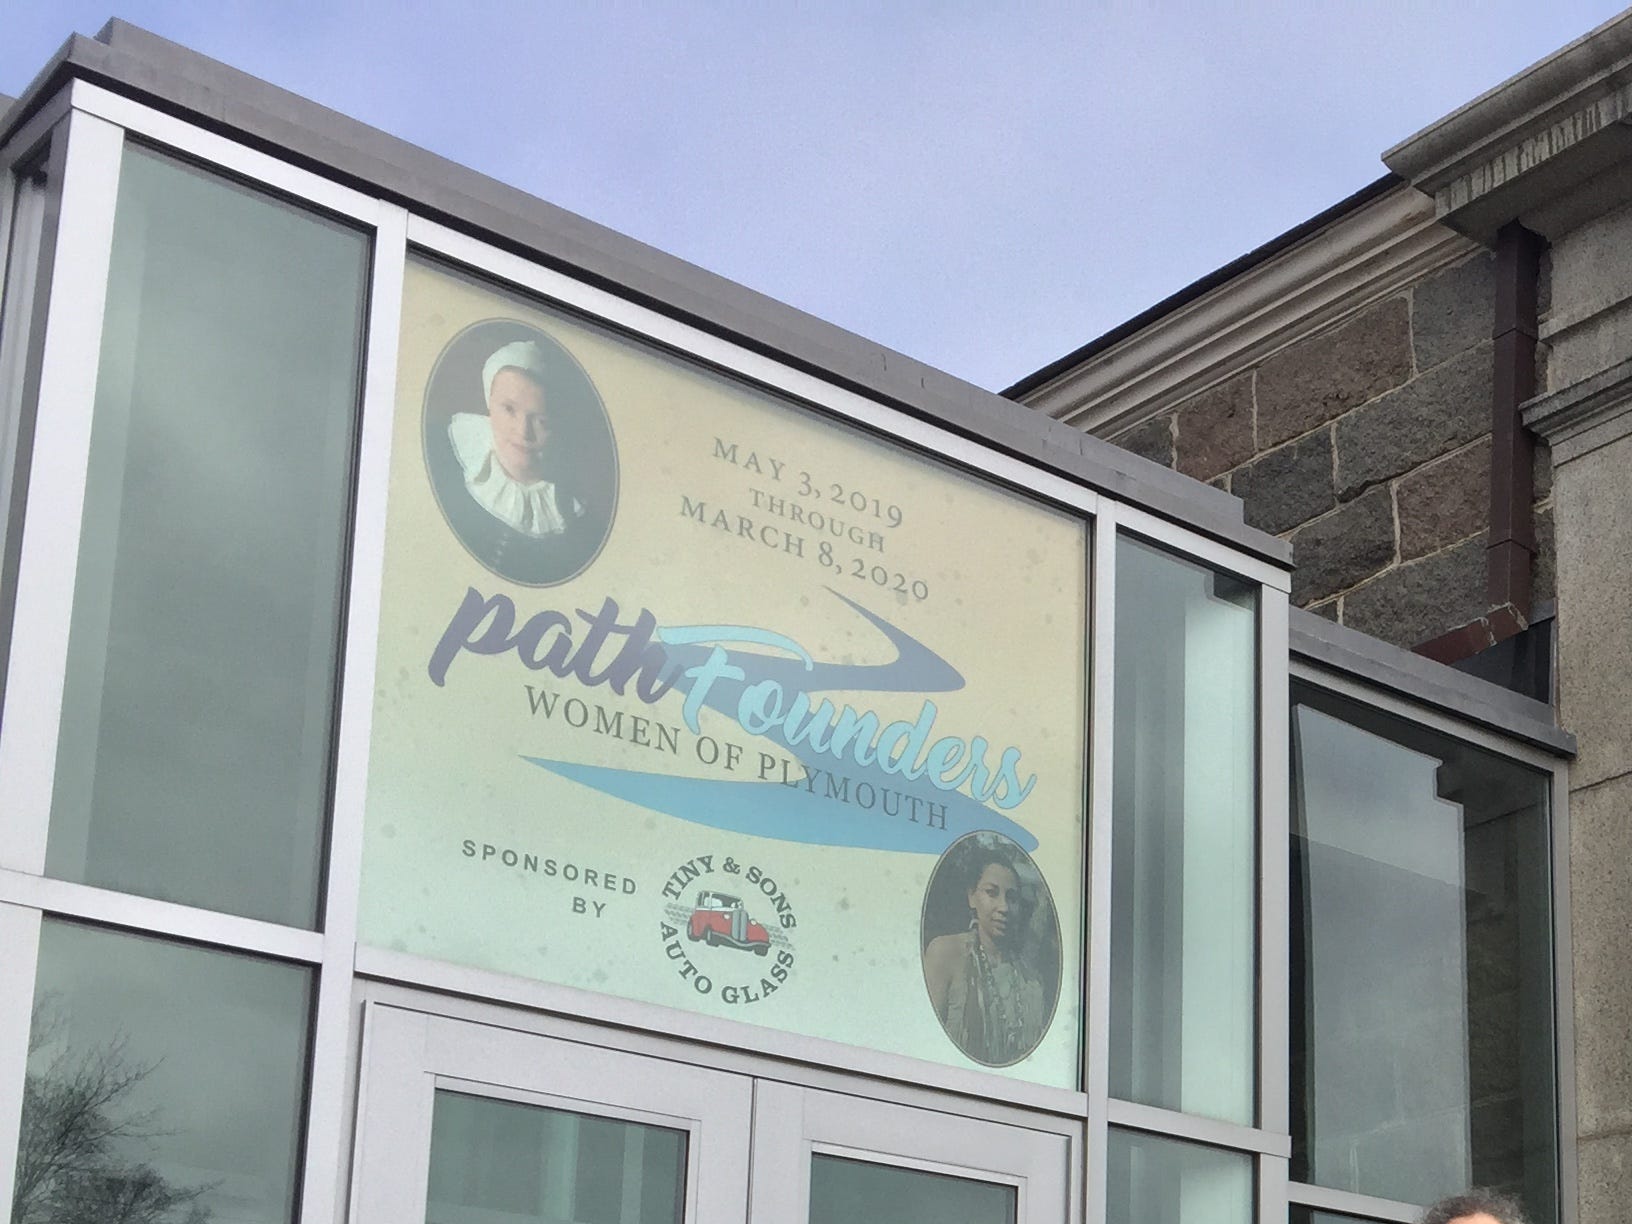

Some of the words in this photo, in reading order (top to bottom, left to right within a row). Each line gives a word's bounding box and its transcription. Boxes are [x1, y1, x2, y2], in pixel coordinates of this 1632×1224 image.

[713, 437, 785, 481] MAY
[797, 471, 821, 499] 3,
[830, 483, 903, 529] 2019
[749, 487, 885, 553] THROUGH
[680, 495, 804, 558] MARCH
[817, 540, 842, 576] 8,
[851, 558, 928, 601] 2020
[523, 684, 681, 755] WOMEN
[695, 735, 744, 771] OF
[758, 753, 949, 832] PLYMOUTH
[462, 839, 637, 895] SPONSORED
[662, 855, 714, 901] TINY
[722, 856, 741, 875] &
[746, 866, 797, 930] SONS
[572, 896, 606, 919] BY
[660, 921, 713, 995] AUTO
[721, 949, 794, 1005] GLASS
